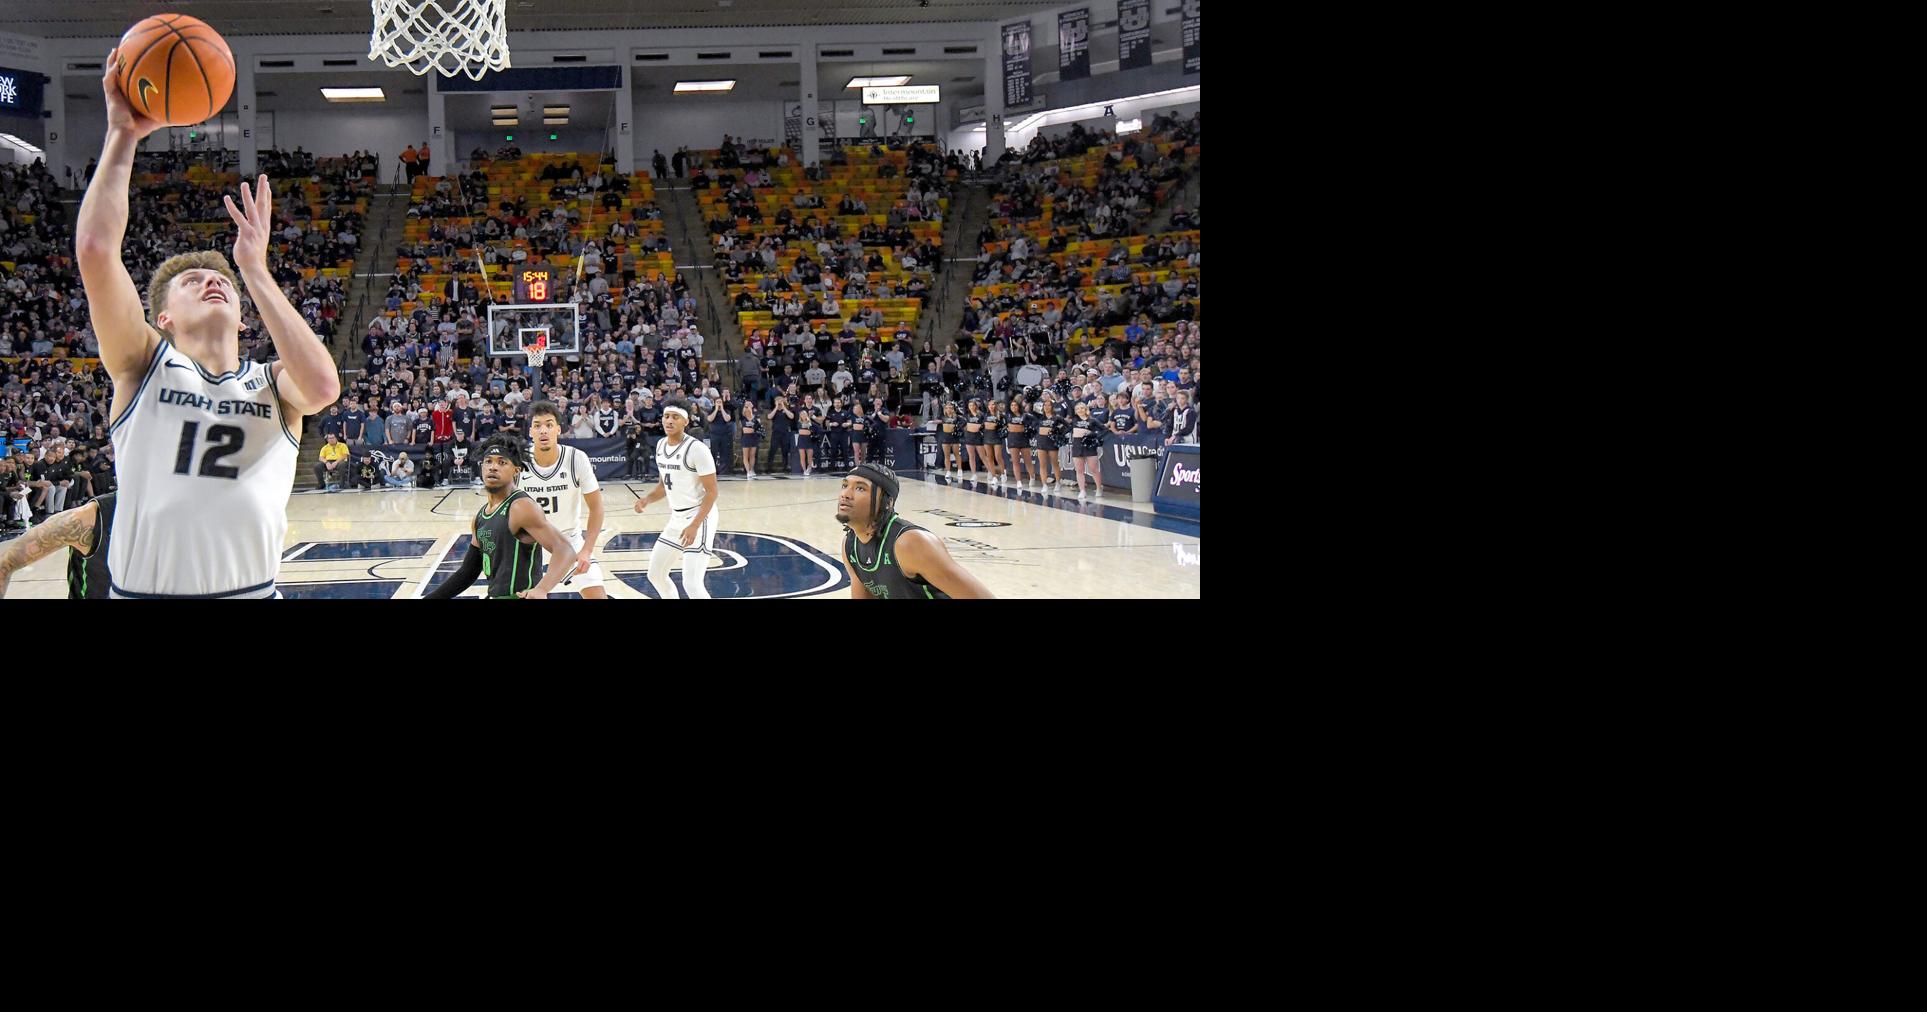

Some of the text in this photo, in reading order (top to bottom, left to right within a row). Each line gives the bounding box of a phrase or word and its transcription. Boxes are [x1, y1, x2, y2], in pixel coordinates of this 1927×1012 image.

[622, 122, 628, 131] F
[806, 117, 815, 126] G
[243, 129, 251, 138] E
[433, 126, 441, 135] F
[50, 132, 58, 141] D
[523, 271, 548, 282] 15:44
[530, 282, 545, 300] 18
[159, 388, 272, 419] UTAH STATE
[173, 420, 245, 480] 12
[664, 473, 673, 490] 4
[524, 484, 569, 493] UTAH STATE
[536, 496, 558, 515] 21
